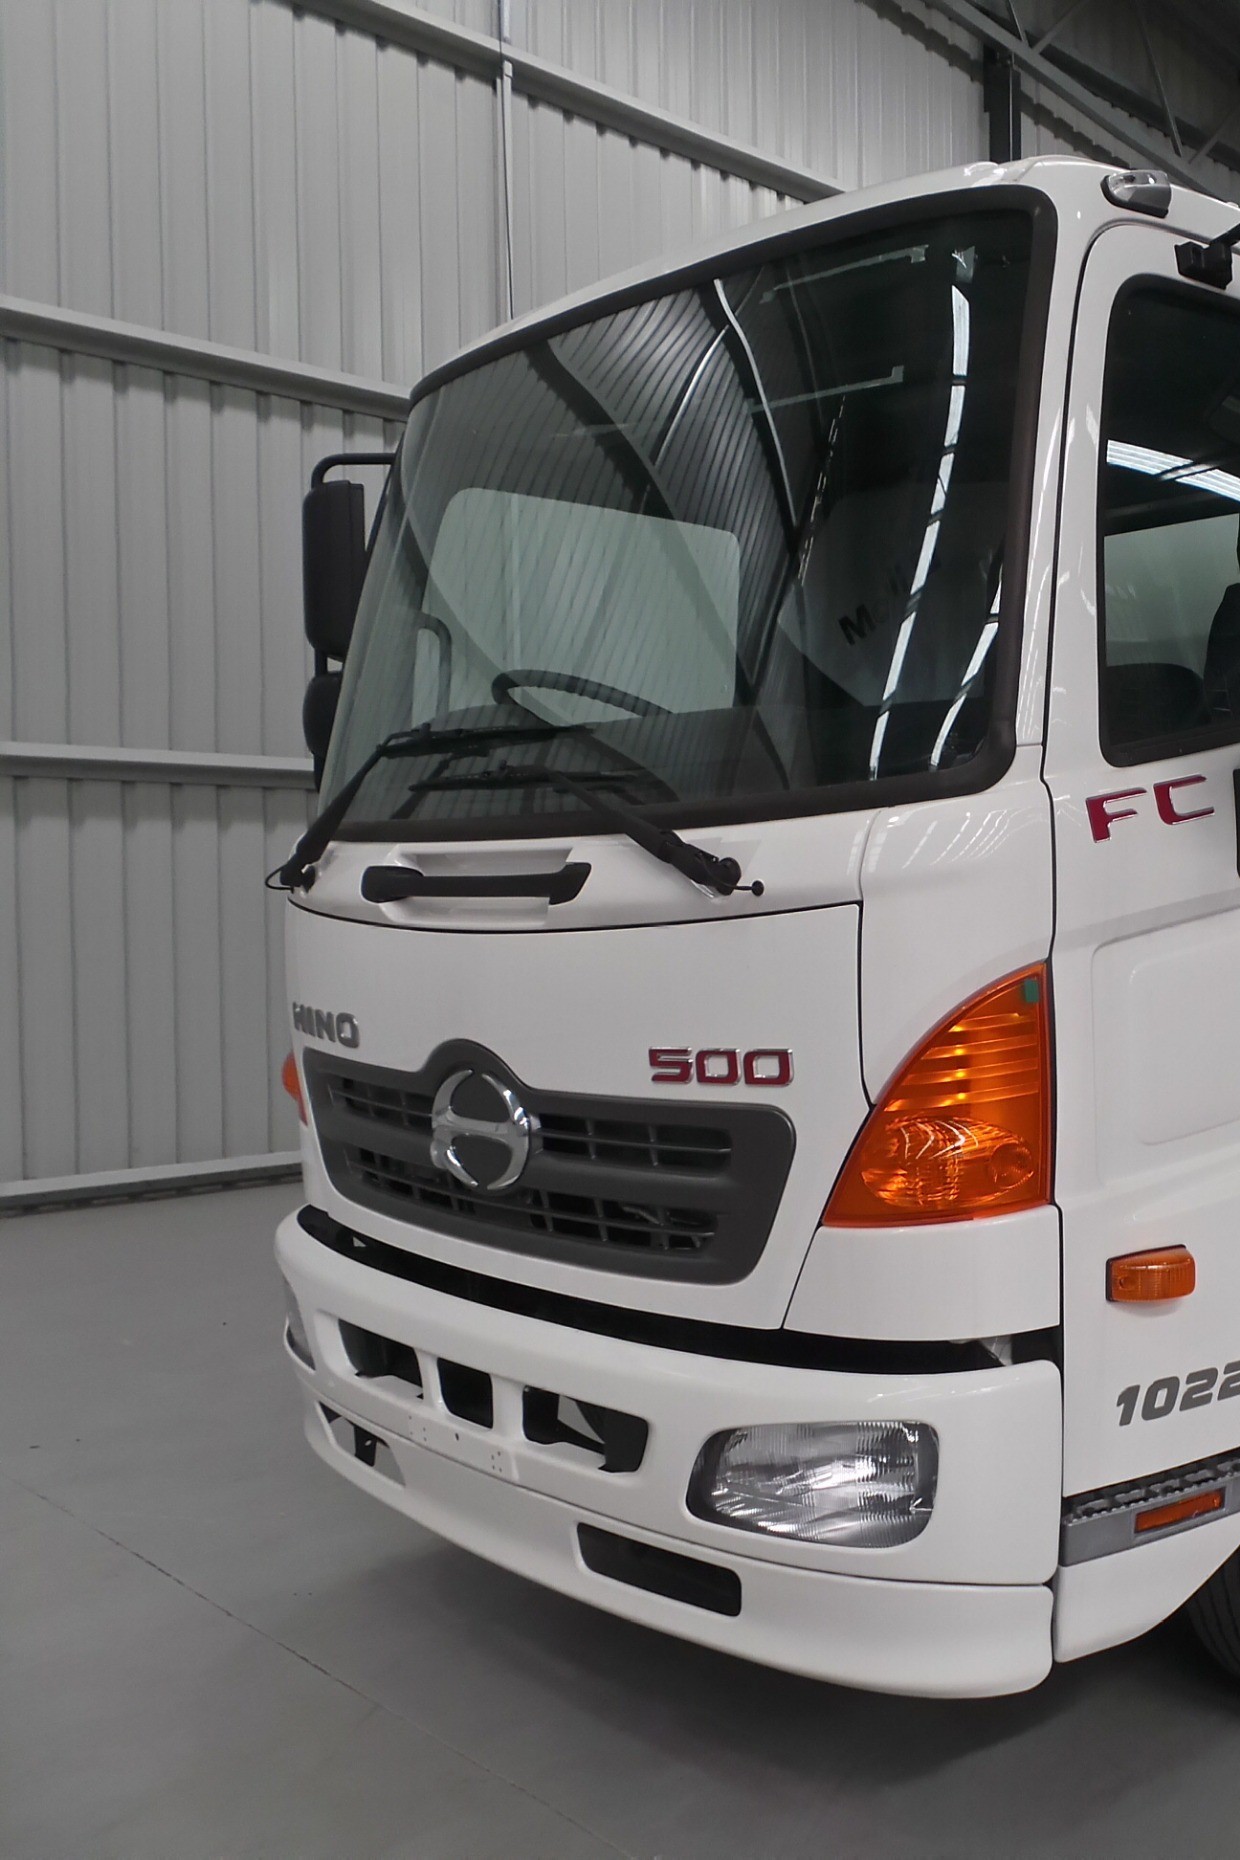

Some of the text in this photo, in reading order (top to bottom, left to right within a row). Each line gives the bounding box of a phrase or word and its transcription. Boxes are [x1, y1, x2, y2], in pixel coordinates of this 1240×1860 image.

[1085, 774, 1215, 843] FC
[292, 1001, 360, 1049] HINO
[649, 1046, 794, 1086] 500
